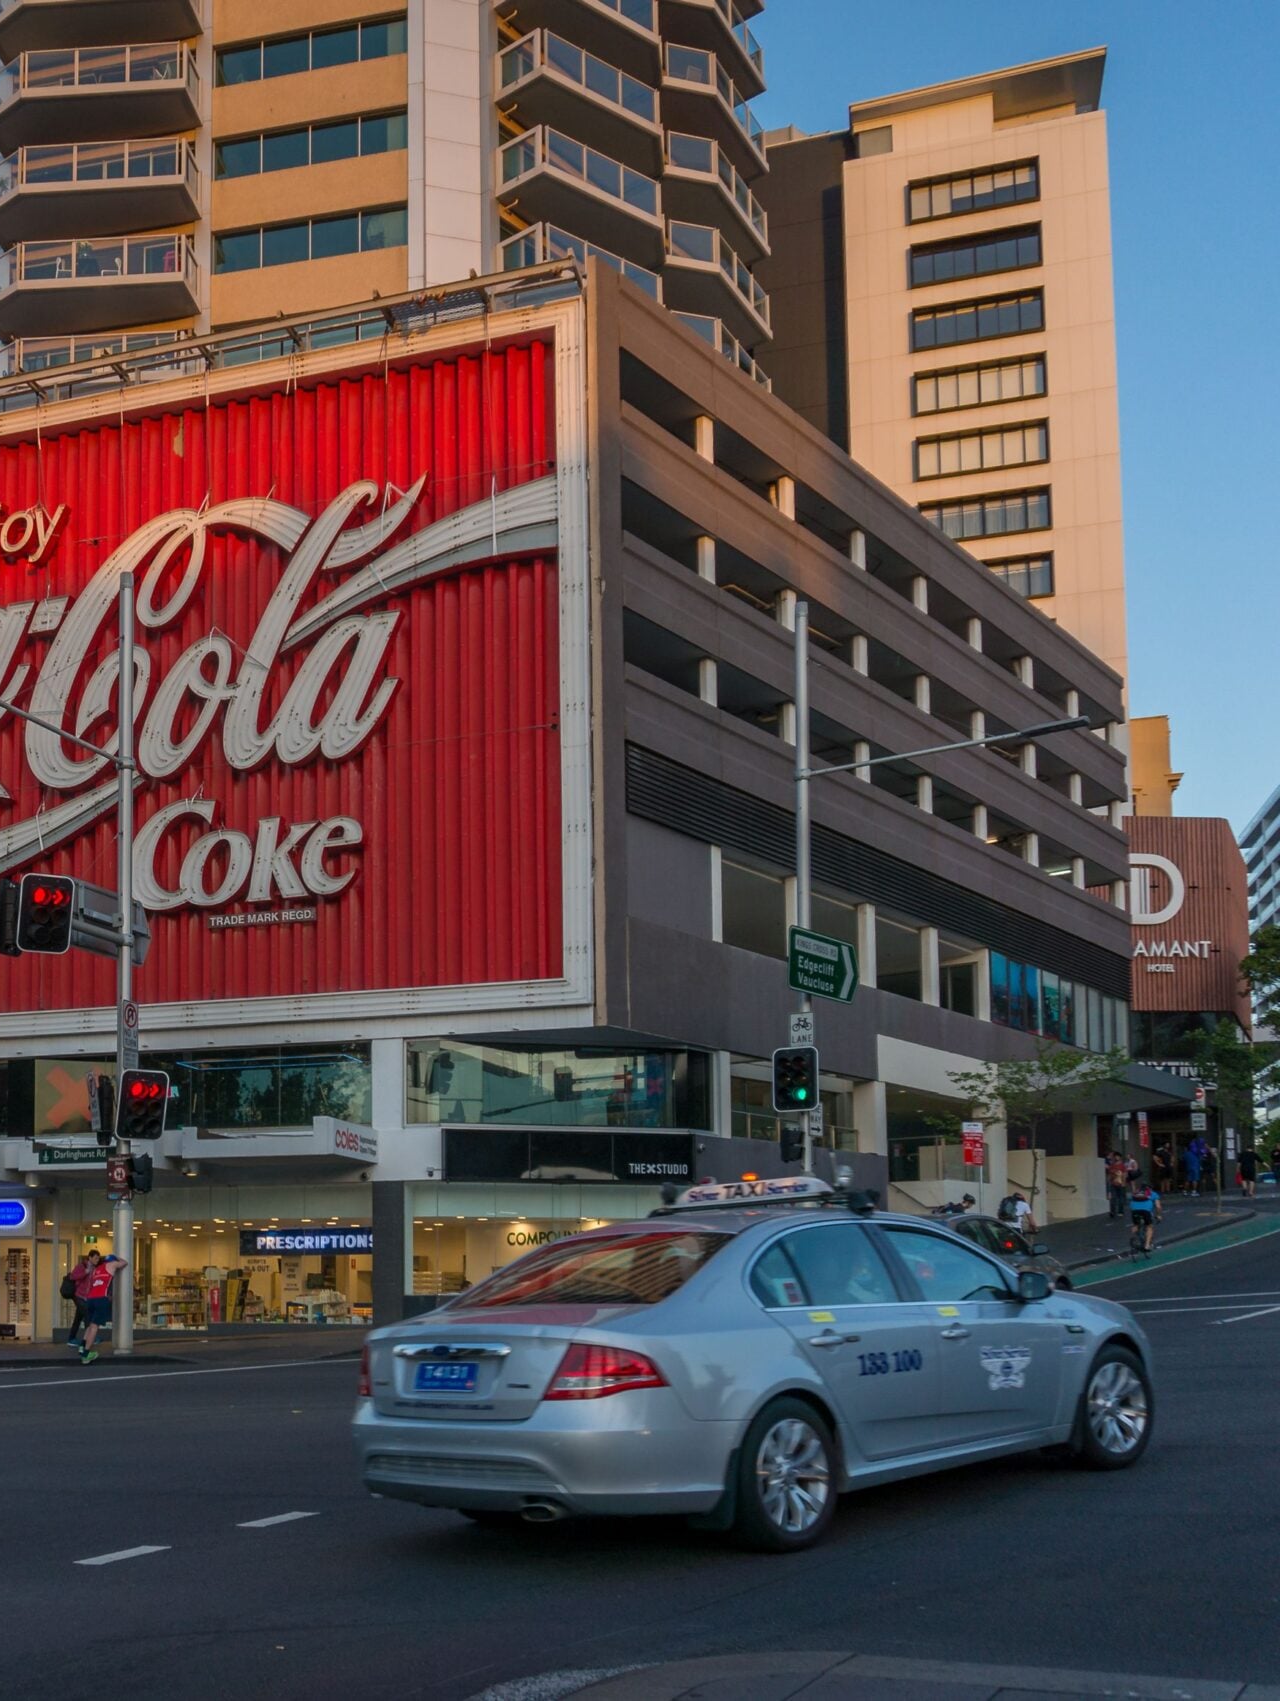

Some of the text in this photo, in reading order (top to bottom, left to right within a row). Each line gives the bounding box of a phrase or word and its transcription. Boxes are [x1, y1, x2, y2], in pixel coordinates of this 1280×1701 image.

[132, 799, 364, 911] Coke
[210, 914, 245, 927] TRADE
[247, 912, 279, 924] MARK
[1133, 939, 1212, 959] AMANT
[798, 955, 835, 977] Edgecliff
[1147, 963, 1176, 973] HOTEL
[797, 971, 834, 993] Vaucluse
[791, 1034, 813, 1044] LANE
[335, 1128, 359, 1152] coles
[53, 1149, 107, 1161] Darlinghurst Rd
[723, 1182, 766, 1199] TAXI
[856, 1349, 923, 1376] 133 100
